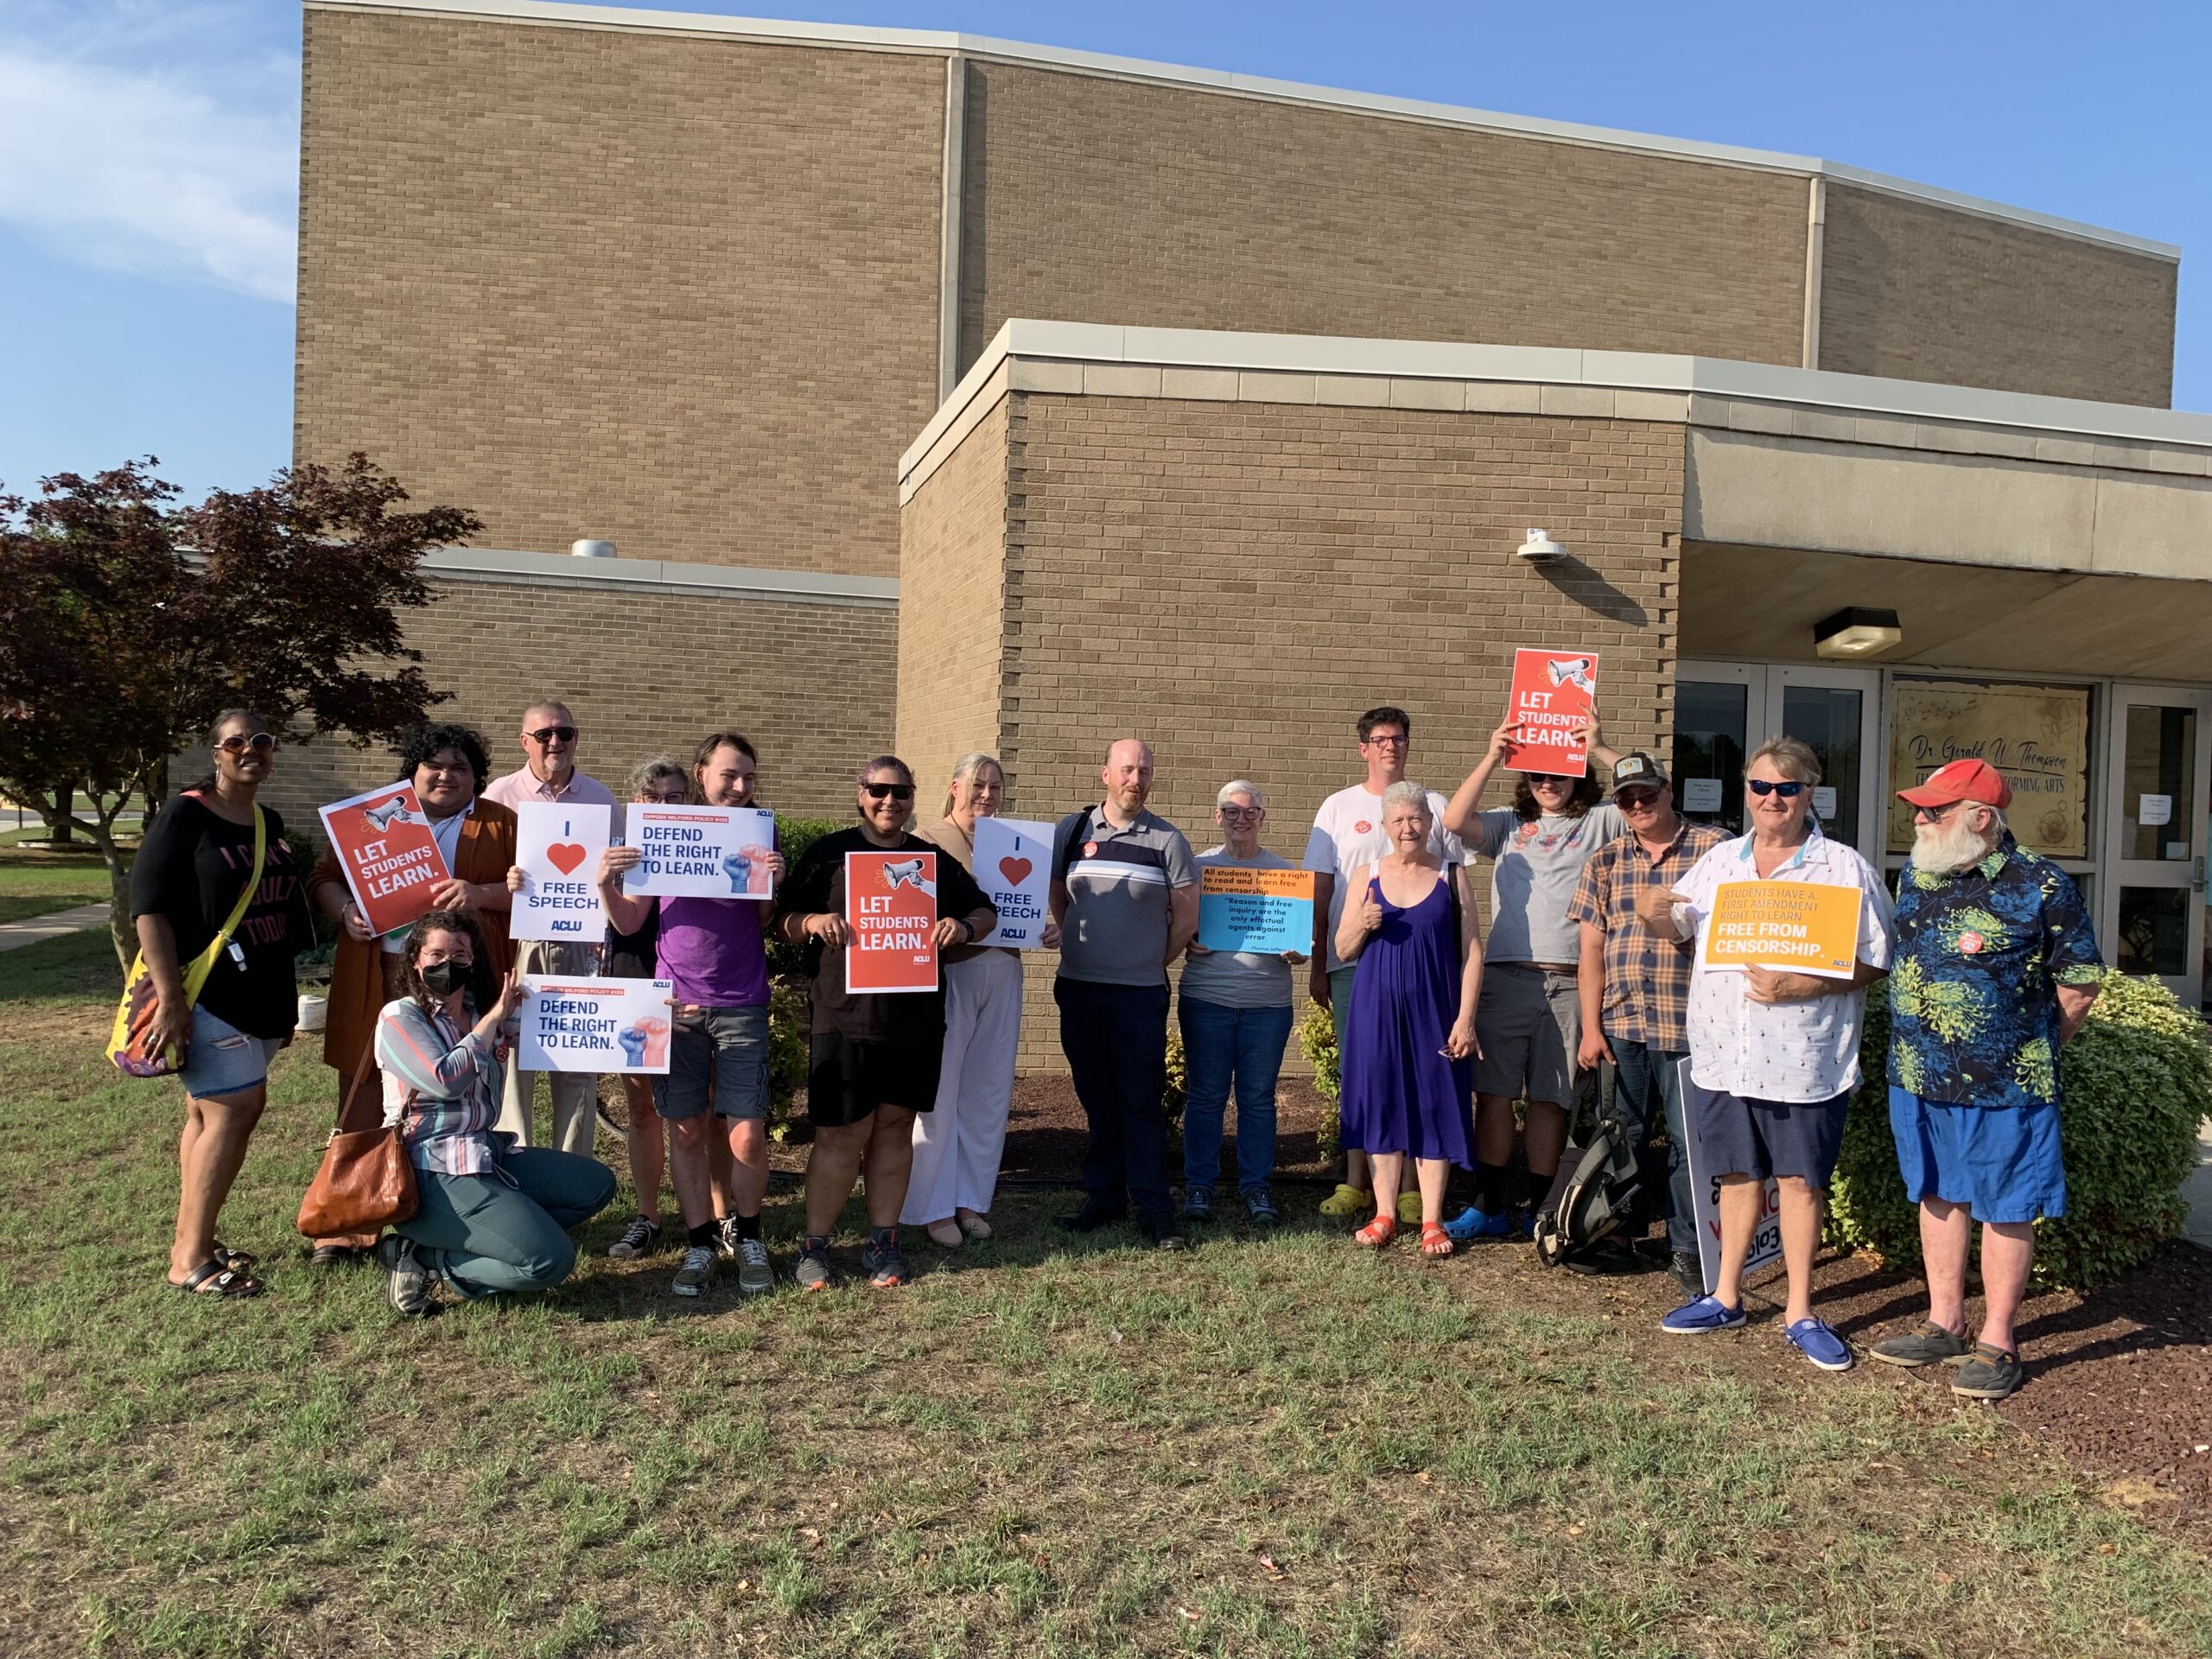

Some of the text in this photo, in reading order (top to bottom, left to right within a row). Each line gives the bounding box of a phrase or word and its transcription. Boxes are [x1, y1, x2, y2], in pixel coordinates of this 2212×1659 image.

[1520, 691, 1553, 709] LET
[1517, 710, 1586, 726] STUDENTS
[1516, 728, 1583, 748] LEARN.
[1908, 734, 1936, 760] Dr.
[1942, 735, 1986, 761] Gerald
[2018, 741, 2067, 775] Thompson
[2044, 778, 2065, 793] ARTS
[565, 821, 569, 836] I
[644, 827, 702, 841] DEFEND
[1015, 836, 1020, 850] I
[219, 847, 237, 869] I
[353, 839, 388, 865] LET
[642, 843, 721, 859] THE RIGHT
[361, 845, 432, 880] STUDENTS
[641, 861, 719, 876] TO LEARN.
[368, 863, 439, 899] LEARN.
[543, 882, 587, 894] FREE
[995, 892, 1032, 905] FREE
[1225, 887, 1268, 895] censorship
[1725, 888, 1815, 900] STUDENTS HAVE A
[529, 896, 599, 909] SPEECH
[860, 897, 893, 913] LET
[1723, 899, 1819, 912] FIRST AMENDMENT
[995, 906, 1040, 919] PEECH
[1229, 906, 1256, 915] inquiry
[1721, 911, 1802, 921] RIGHT TO LEARN
[551, 920, 582, 931] ACLU
[860, 917, 928, 929] STUDENTS
[1229, 925, 1254, 933] agents
[1718, 923, 1807, 938] FREE FROM
[1001, 928, 1027, 939] ACLU
[861, 933, 926, 950] LEARN.
[1715, 939, 1825, 958] CENSORSHIP.
[541, 1000, 598, 1014] DEFEND
[539, 1017, 617, 1033] THE RIGHT
[538, 1034, 613, 1050] TO LEARN.
